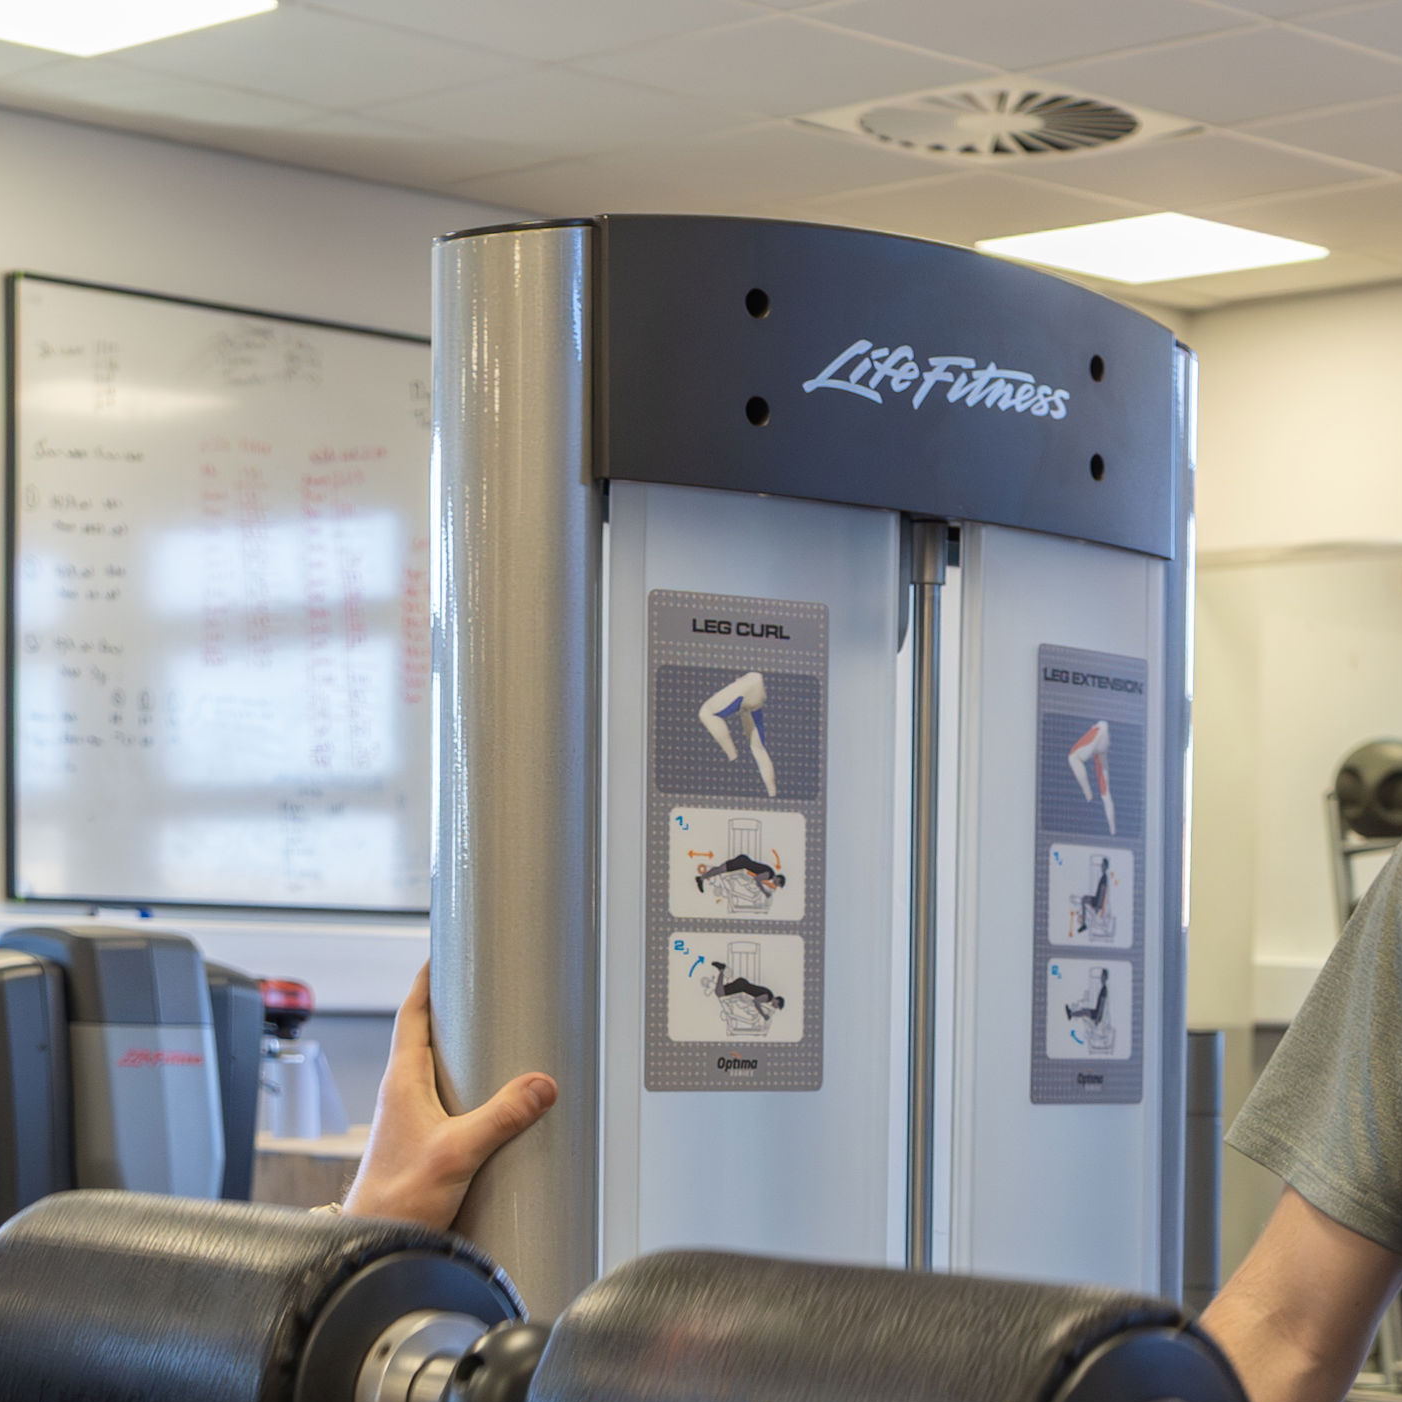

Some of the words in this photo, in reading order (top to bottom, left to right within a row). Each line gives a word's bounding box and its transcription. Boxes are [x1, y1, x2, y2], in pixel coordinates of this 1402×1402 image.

[802, 338, 920, 404] Life
[912, 355, 1071, 420] Fitness
[692, 618, 732, 635] LEG
[736, 622, 790, 640] CURL
[1043, 667, 1069, 683] LEG
[717, 1056, 758, 1072] Optima
